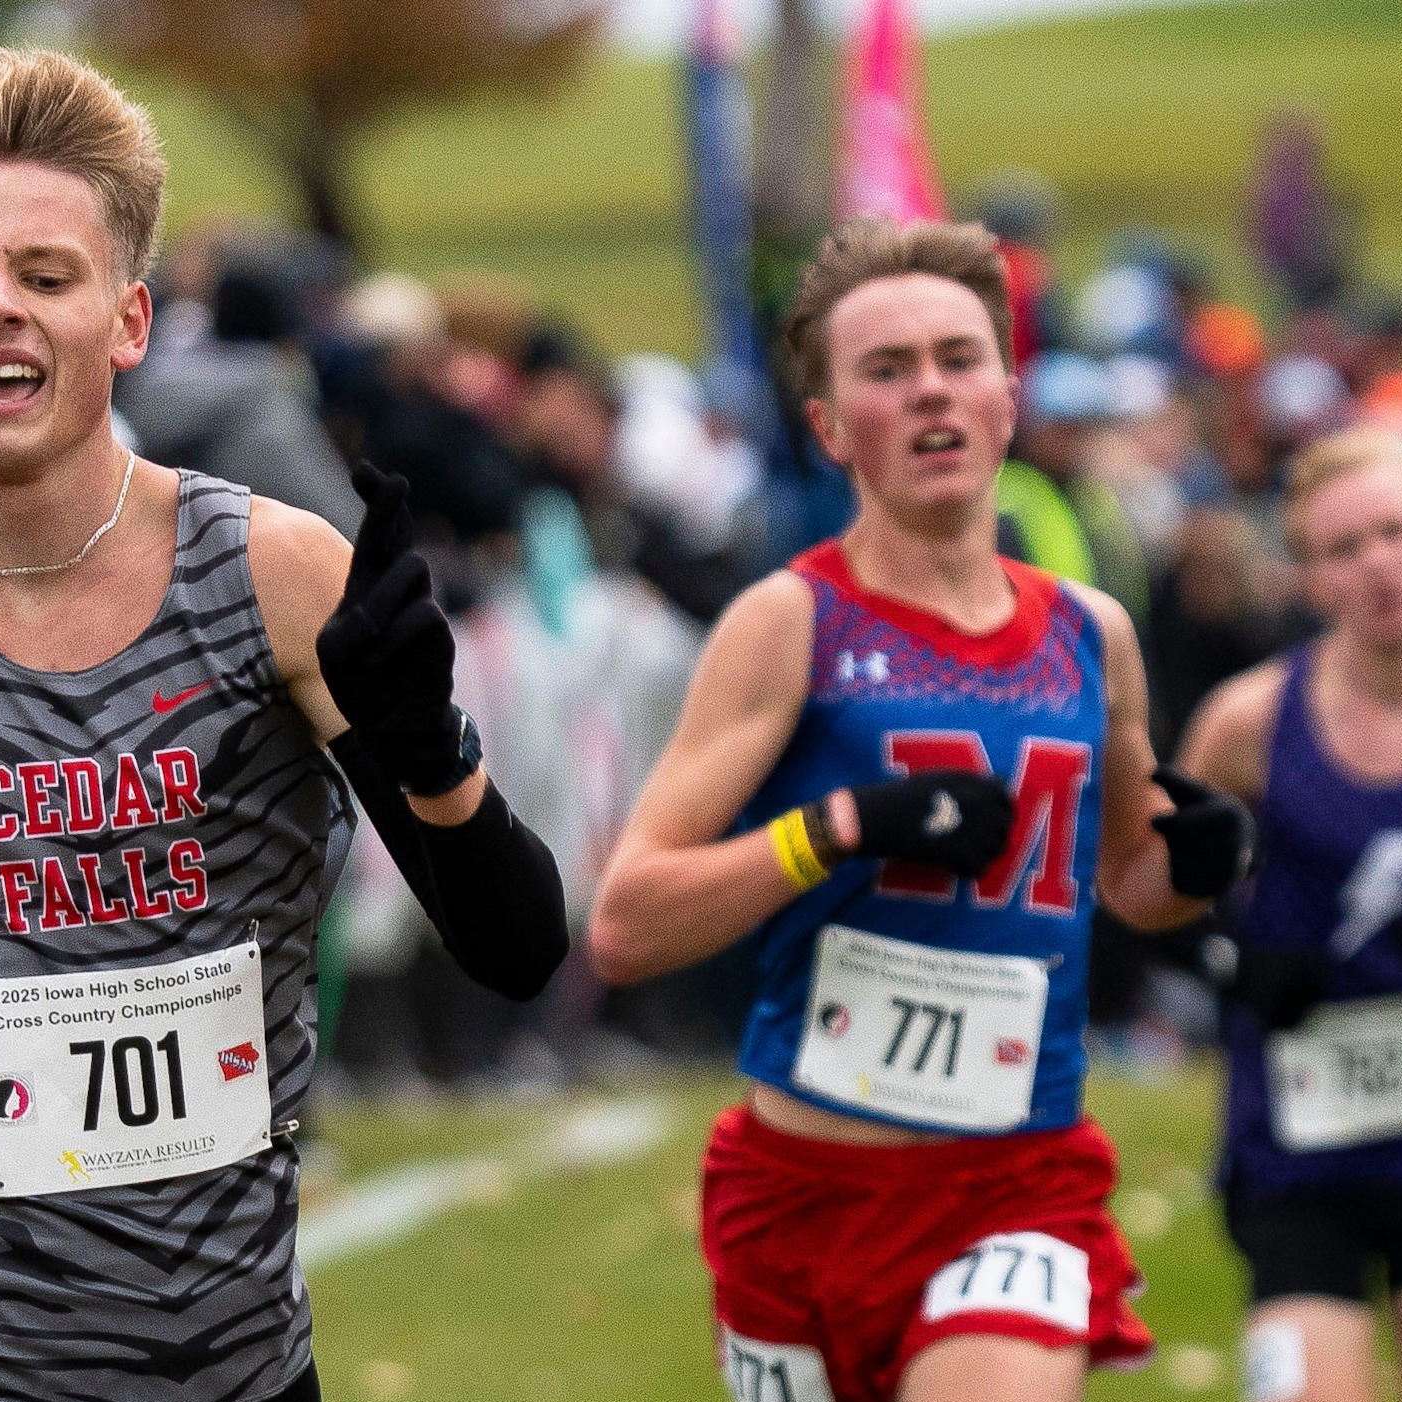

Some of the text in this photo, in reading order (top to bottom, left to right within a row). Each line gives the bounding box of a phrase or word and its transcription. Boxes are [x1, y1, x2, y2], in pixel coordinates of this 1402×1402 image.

[874, 728, 1093, 919] M
[1, 962, 232, 1004] 2025 Iowa High School State
[48, 1008, 116, 1025] Country
[121, 983, 242, 1019] Championships
[884, 996, 965, 1077] 771
[69, 1030, 187, 1131] 701
[81, 1148, 154, 1167] WAYZATA
[156, 1134, 216, 1158] RESULTS
[953, 1243, 1056, 1303] 771
